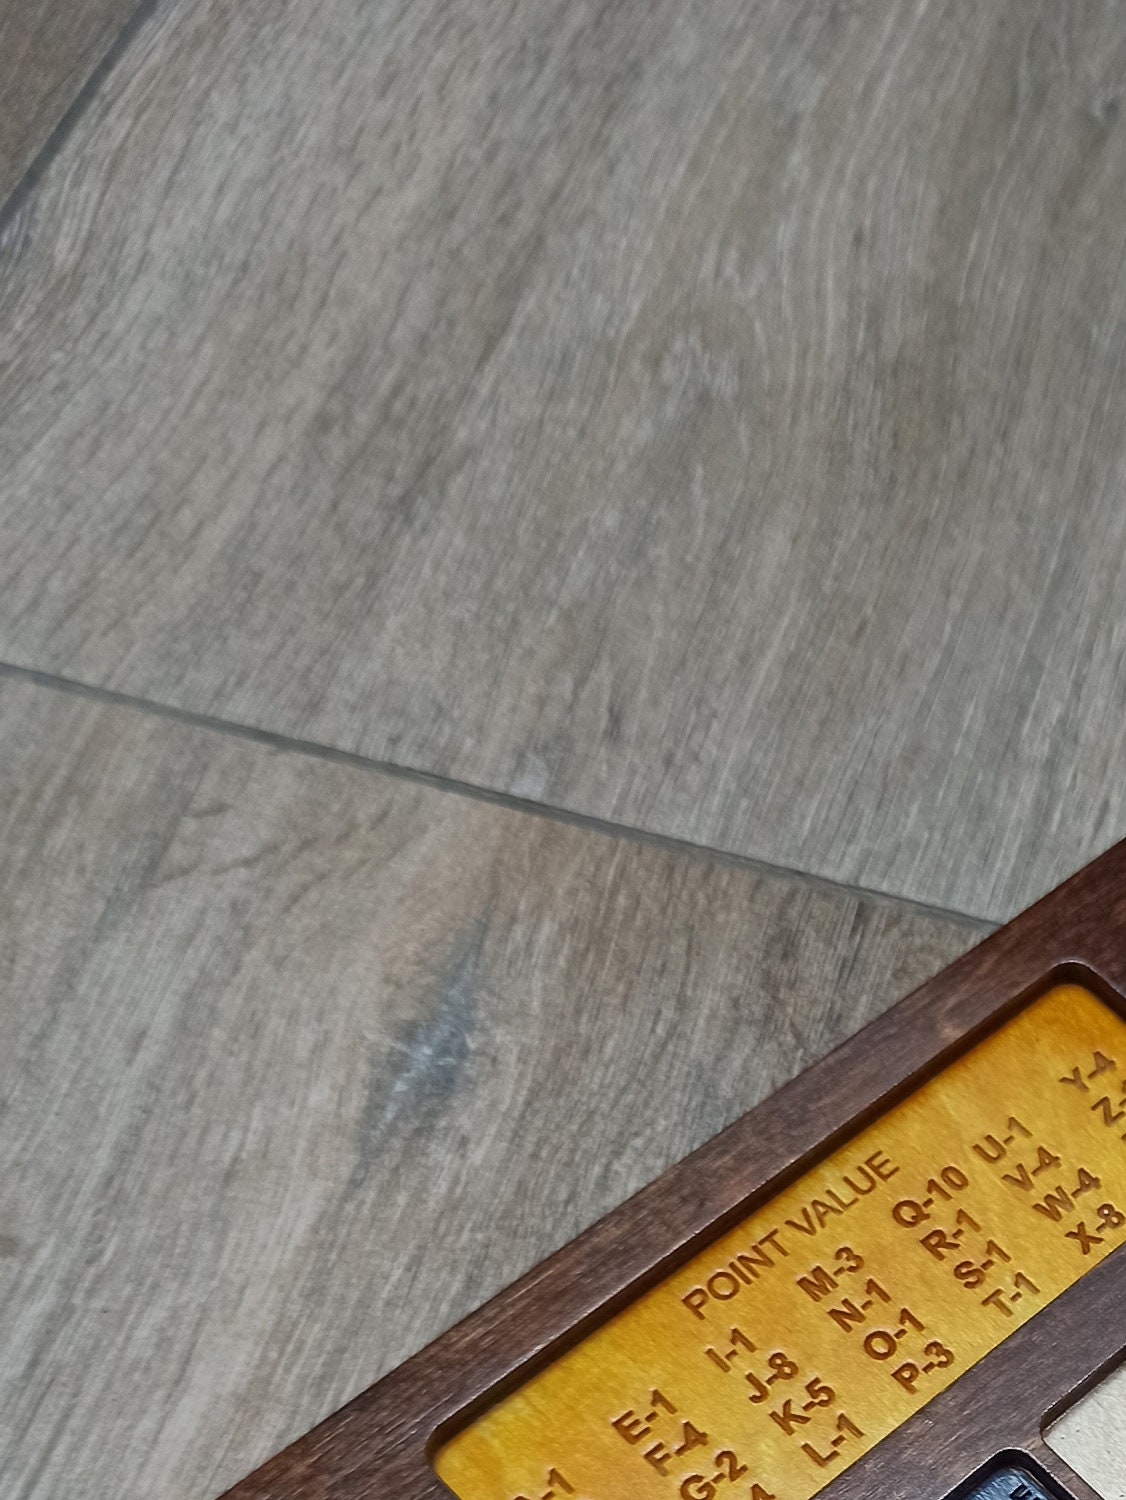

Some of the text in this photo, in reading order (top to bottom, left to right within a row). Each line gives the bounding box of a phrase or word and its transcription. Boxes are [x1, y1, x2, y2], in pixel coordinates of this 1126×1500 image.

[611, 1388, 678, 1445] E-1
[705, 1327, 758, 1373] I-1
[797, 1246, 865, 1302] M-3
[892, 1165, 970, 1228] Q-10
[972, 1116, 1033, 1164] U-1
[1058, 1051, 1116, 1093] Y-4
[643, 1420, 709, 1477] F-4
[745, 1352, 798, 1404] J-8
[827, 1278, 892, 1333] N-1
[919, 1209, 982, 1262] R-1
[1001, 1145, 1062, 1193] V-4
[681, 1150, 900, 1320] POINT VALUE
[768, 1376, 836, 1436] K-5
[863, 1308, 926, 1361] O-1
[953, 1239, 1012, 1289] S-1
[1032, 1167, 1102, 1222] W-4
[801, 1412, 865, 1468] L-1
[890, 1340, 955, 1395] P-3
[981, 1271, 1041, 1318] T-1
[1064, 1203, 1126, 1255] X-8
